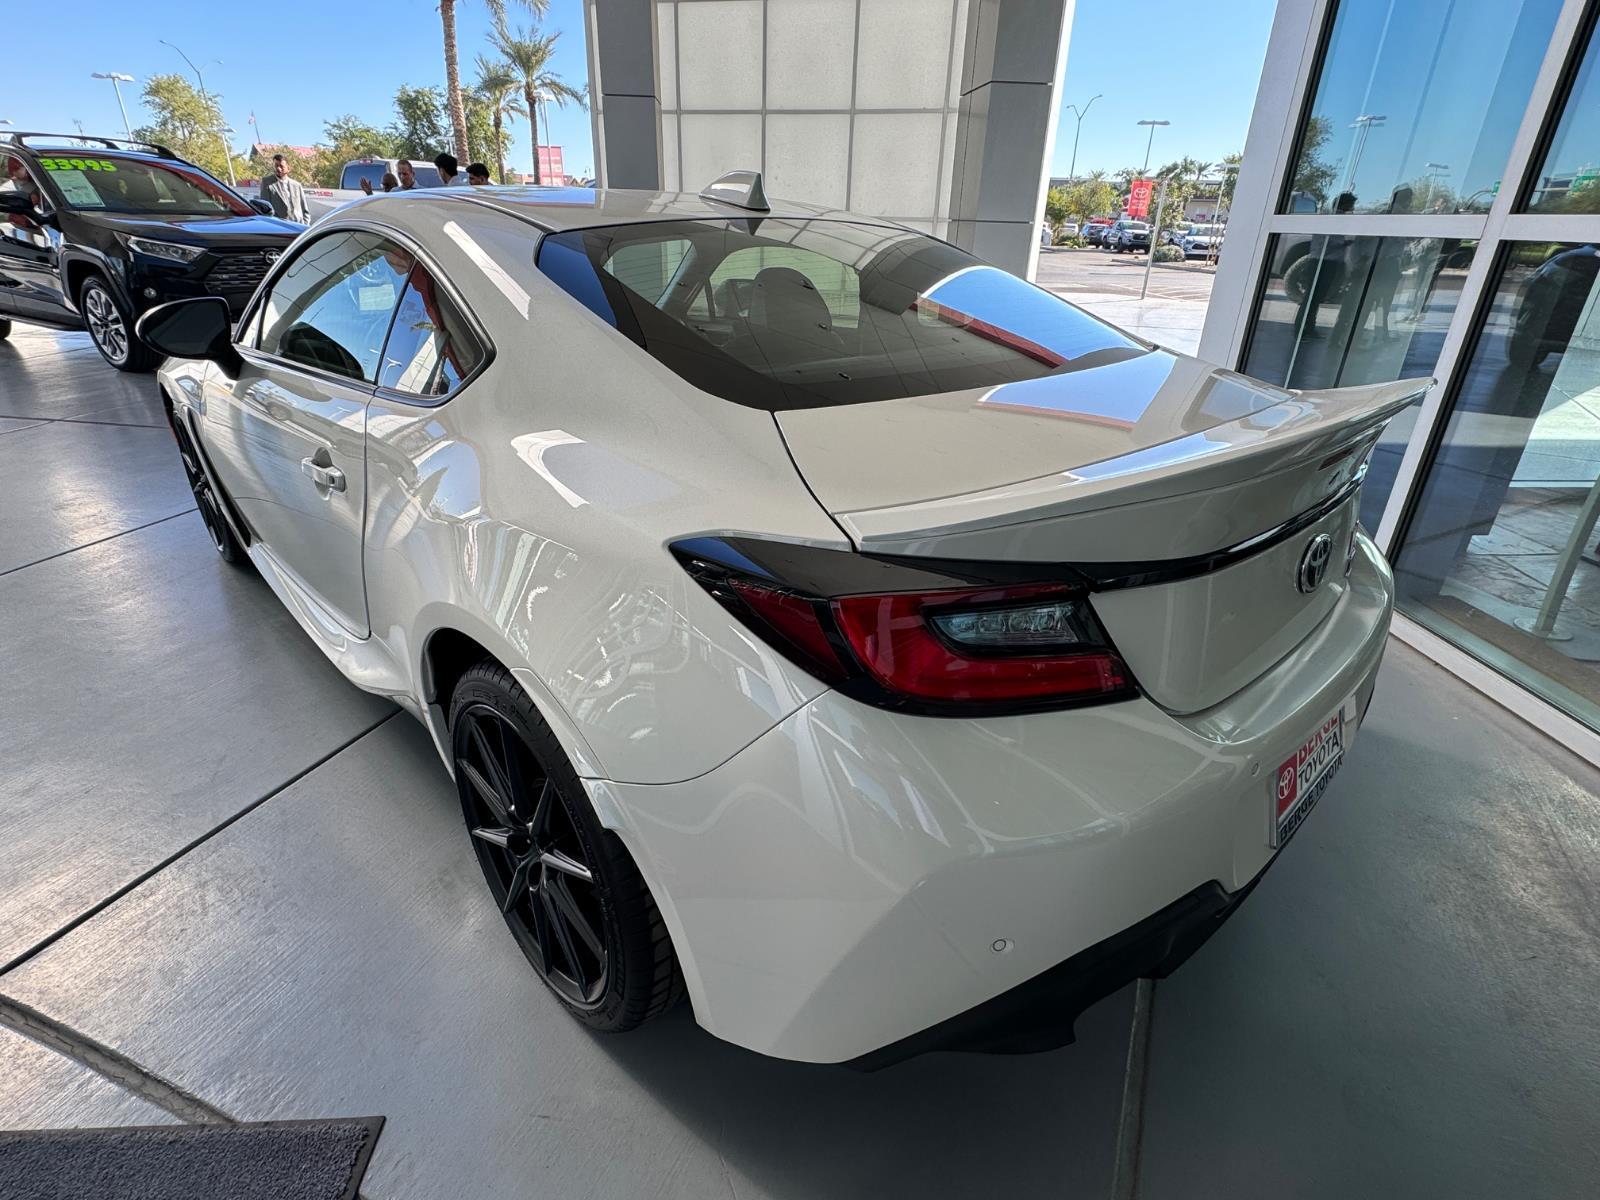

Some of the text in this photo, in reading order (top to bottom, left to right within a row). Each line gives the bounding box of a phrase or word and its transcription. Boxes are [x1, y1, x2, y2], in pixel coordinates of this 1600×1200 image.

[40, 158, 117, 171] 33995
[1298, 731, 1339, 790] TOYOTA
[1280, 755, 1342, 842] BERGE TOYOTA
